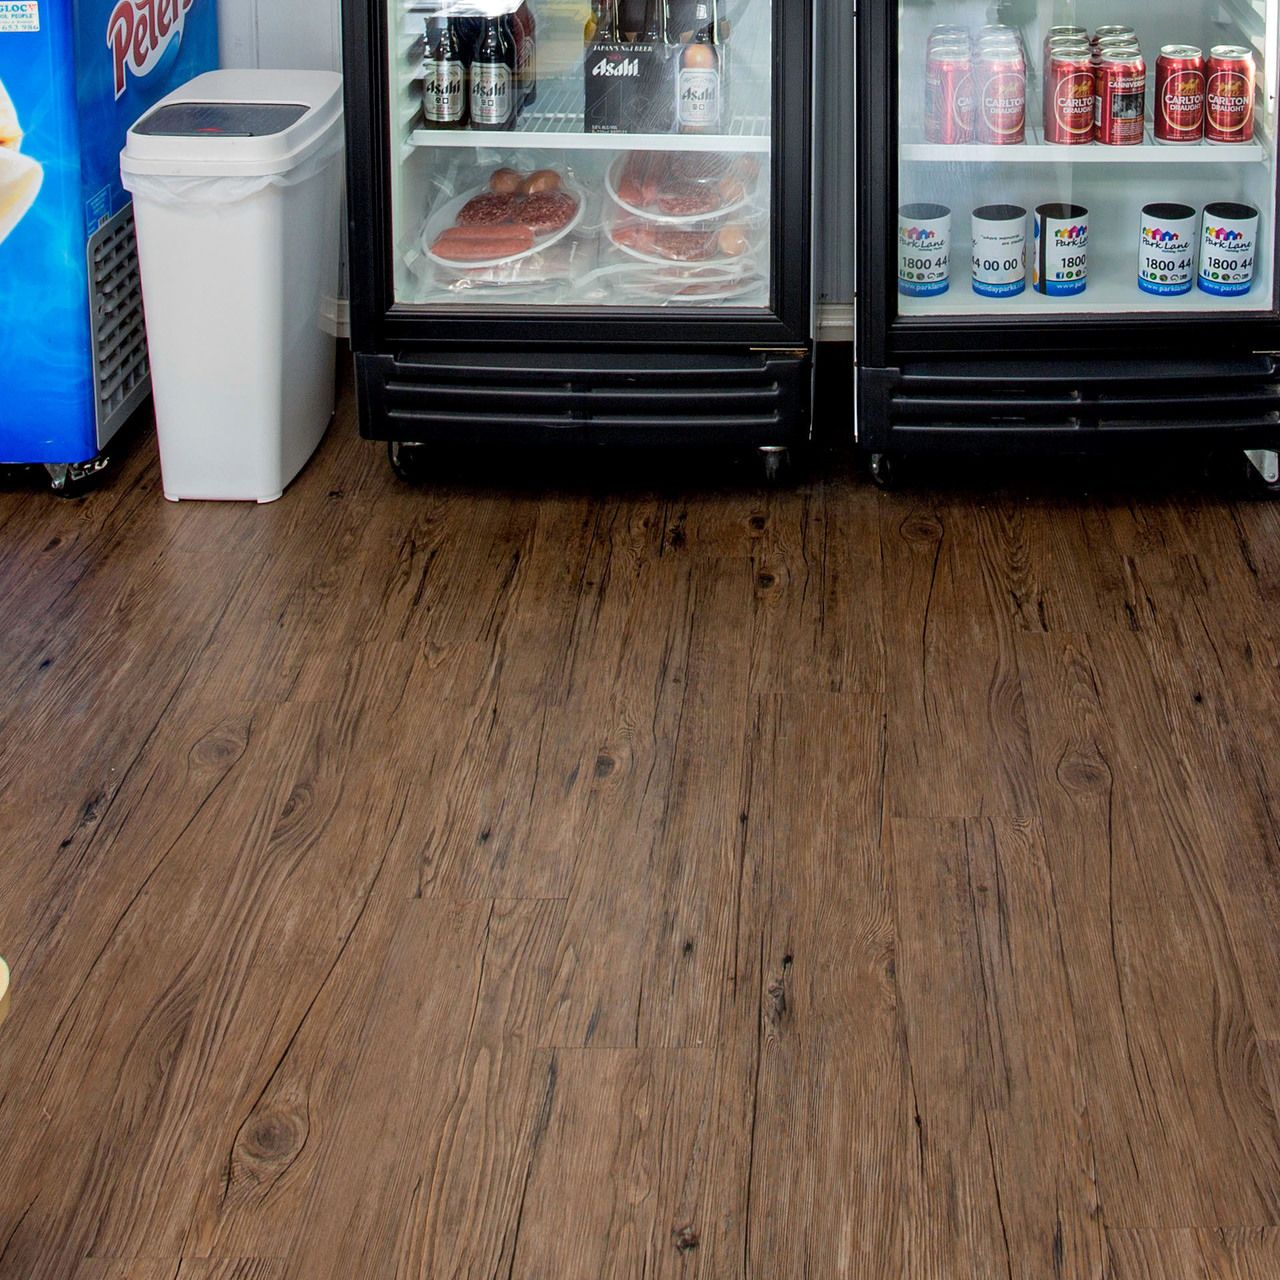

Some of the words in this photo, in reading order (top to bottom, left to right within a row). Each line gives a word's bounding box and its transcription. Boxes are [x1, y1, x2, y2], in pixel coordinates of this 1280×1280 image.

[592, 54, 639, 77] Asahi
[426, 79, 461, 96] Asahi
[1208, 93, 1249, 107] CARLTON
[1212, 104, 1244, 115] DRAUGHT
[1145, 257, 1175, 271] 1800
[1207, 257, 1237, 271] 1800
